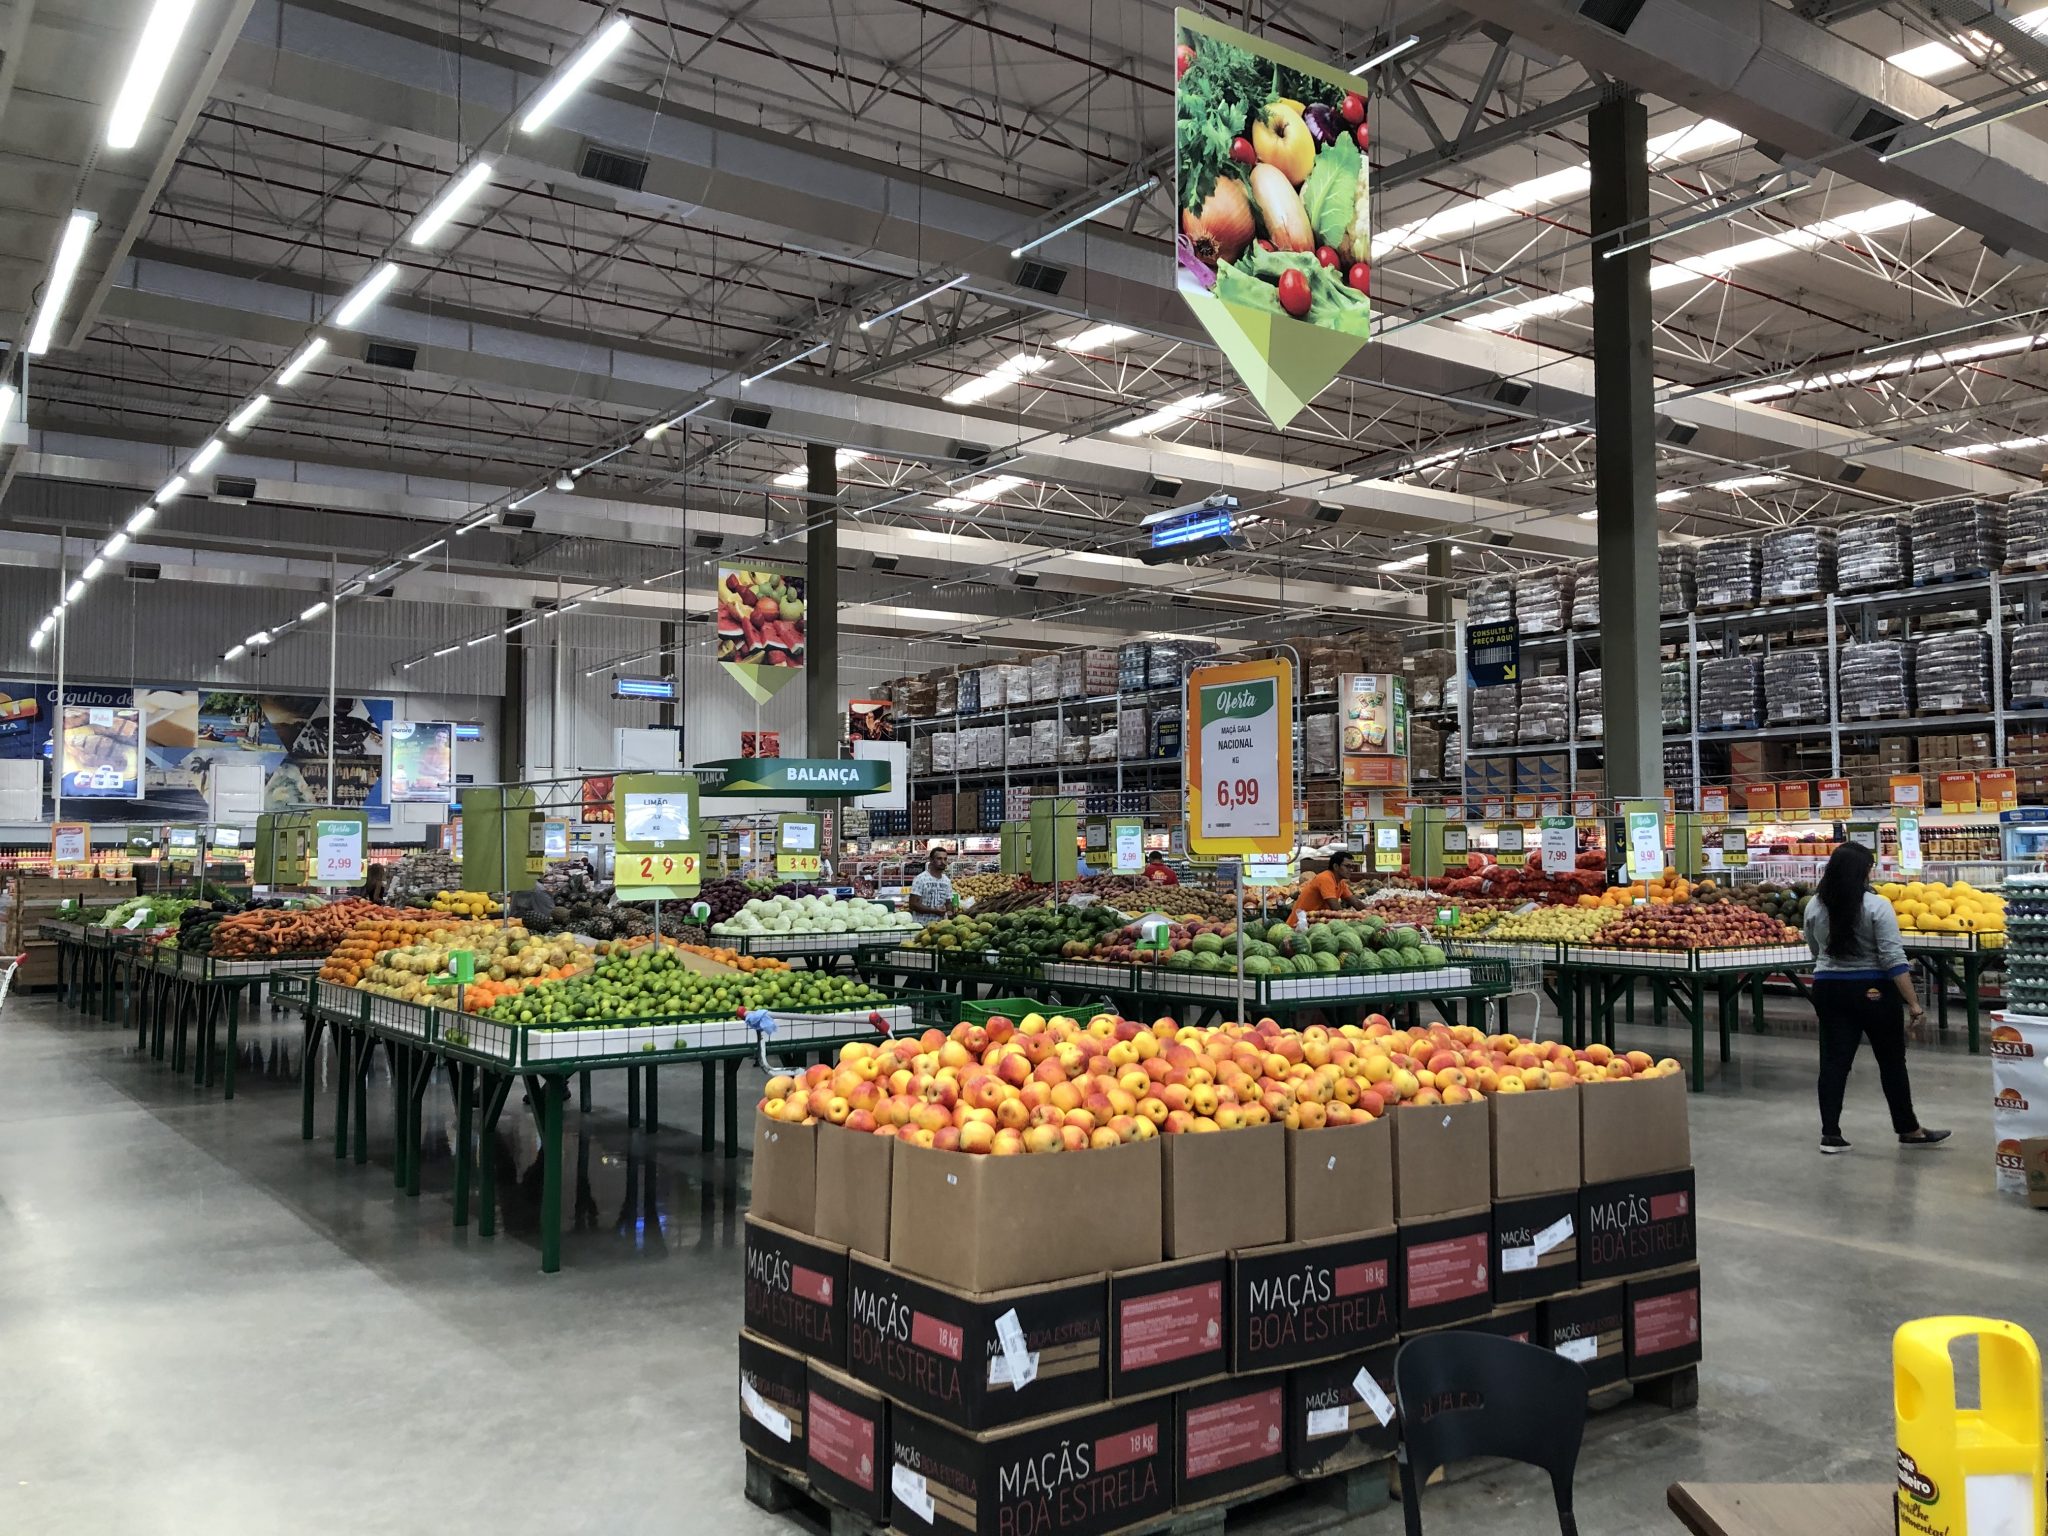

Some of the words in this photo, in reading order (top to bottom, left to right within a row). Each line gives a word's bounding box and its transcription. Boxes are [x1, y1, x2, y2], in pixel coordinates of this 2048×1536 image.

[1472, 637, 1495, 646] PREÇO
[1473, 627, 1506, 638] CONSULTE
[1508, 625, 1514, 633] O
[1216, 689, 1257, 714] Oferta
[1221, 726, 1237, 736] MAÇÃ
[1237, 724, 1252, 733] GALA
[1217, 738, 1254, 751] NACIONAL
[1231, 756, 1240, 764] KG
[786, 767, 860, 786] BALANÇA
[1946, 774, 1966, 782] OFERTA
[1217, 778, 1259, 811] 6,99
[327, 858, 352, 870] 2,99
[1547, 850, 1567, 862] 7,99
[1996, 1099, 2026, 1110] ASSAÍ
[1590, 1193, 1649, 1237] MAÇÃS
[1501, 1226, 1531, 1247] MAÇÃS
[1591, 1232, 1627, 1265] BOA
[1629, 1221, 1690, 1258] ESTRELA
[747, 1245, 790, 1295] MAÇÃS
[1250, 1264, 1332, 1317] MAÇÃS
[1364, 1269, 1374, 1284] 18
[1375, 1267, 1385, 1285] kg
[853, 1286, 910, 1343] MAÇÃS
[939, 1327, 948, 1347] 18
[948, 1331, 959, 1356] kg
[1250, 1311, 1297, 1351] BOA
[1303, 1294, 1388, 1343] ESTRELA
[1553, 1322, 1581, 1343] MAÇÃS
[853, 1322, 884, 1371] BOA
[887, 1339, 963, 1405] ESTRELA
[1306, 1388, 1339, 1410] MAÇÃS
[894, 1440, 921, 1469] MAÇÃS
[1000, 1439, 1090, 1502] MAÇÃS
[1129, 1436, 1141, 1453] 18
[1142, 1432, 1154, 1451] kg
[1000, 1495, 1051, 1536] BOA
[1059, 1461, 1159, 1527] ESTRELA
